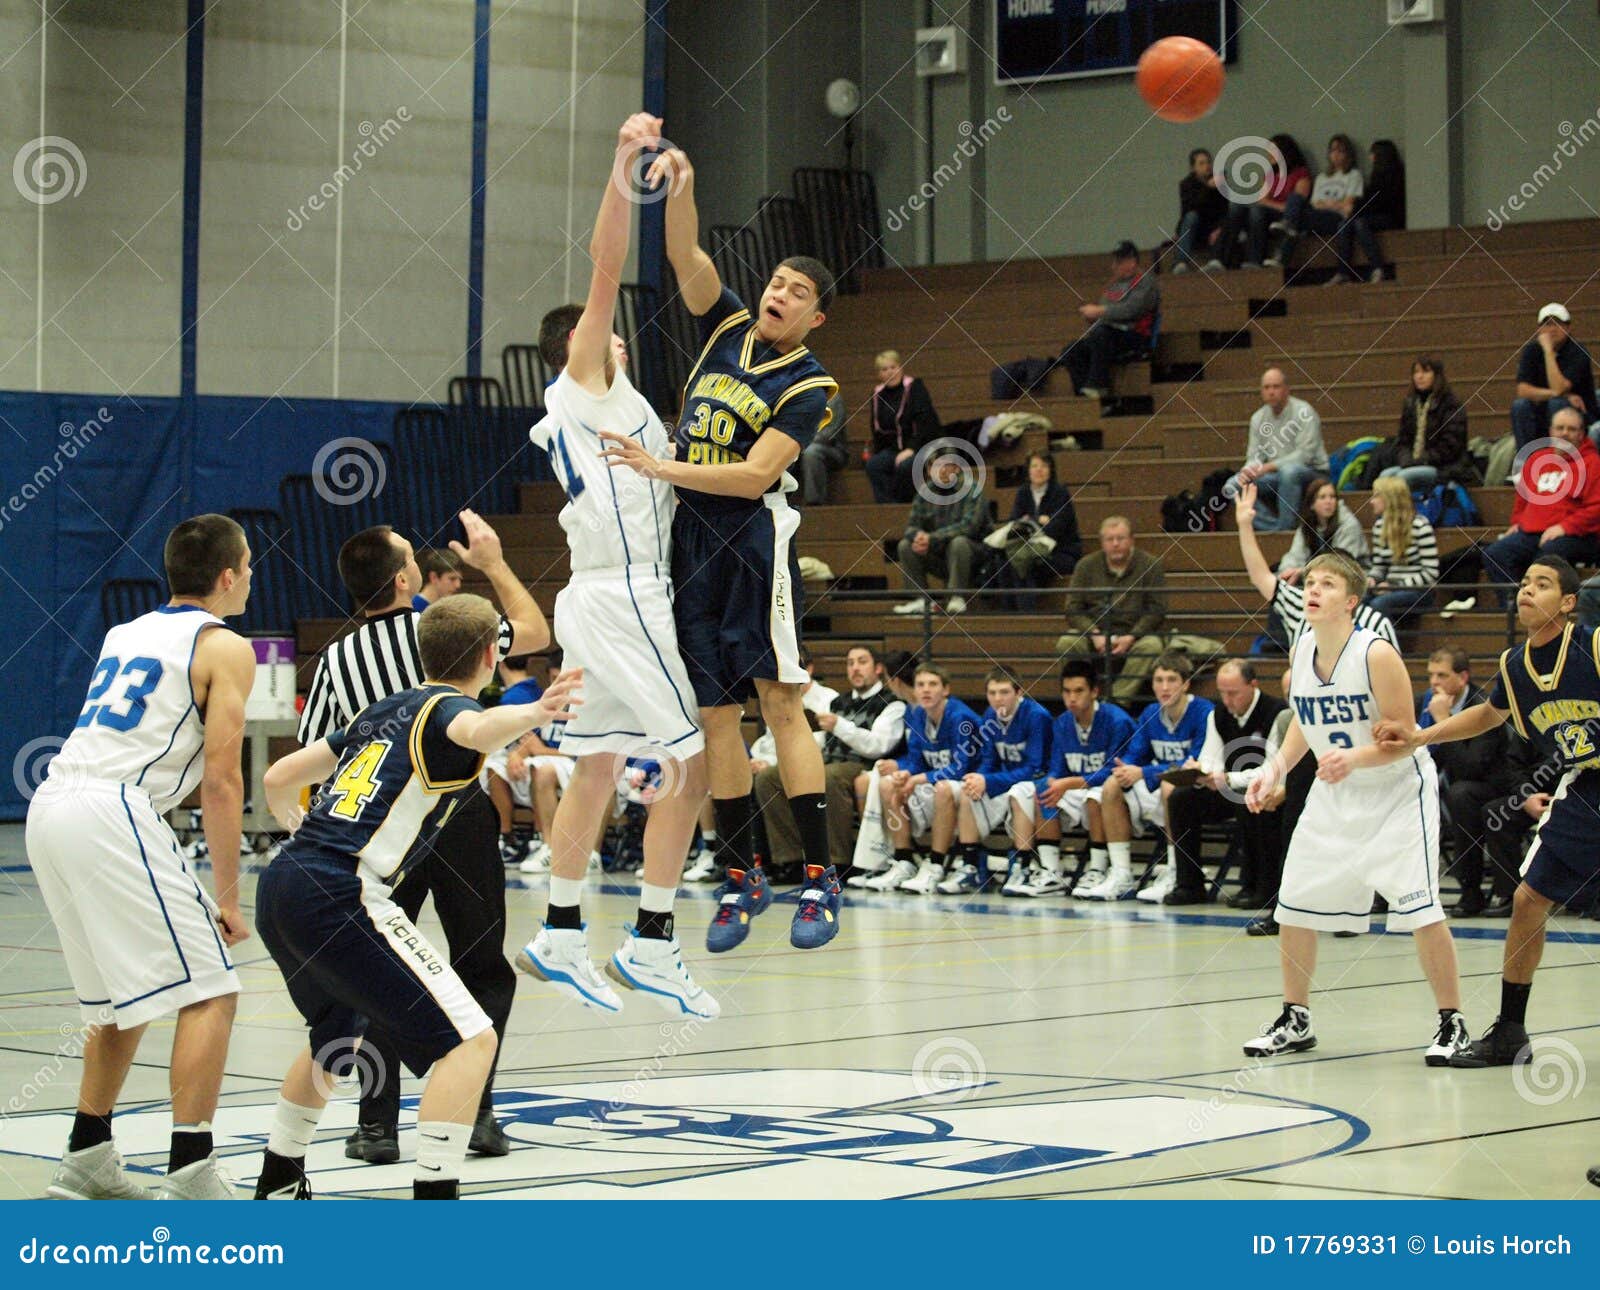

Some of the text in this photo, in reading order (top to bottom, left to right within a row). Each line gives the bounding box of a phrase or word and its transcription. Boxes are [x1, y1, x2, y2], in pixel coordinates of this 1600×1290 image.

[688, 402, 737, 446] 30
[75, 656, 164, 732] 23
[1293, 693, 1369, 725] WEST
[1150, 739, 1193, 761] WEST
[1554, 724, 1595, 759] 12
[922, 749, 952, 769] WES
